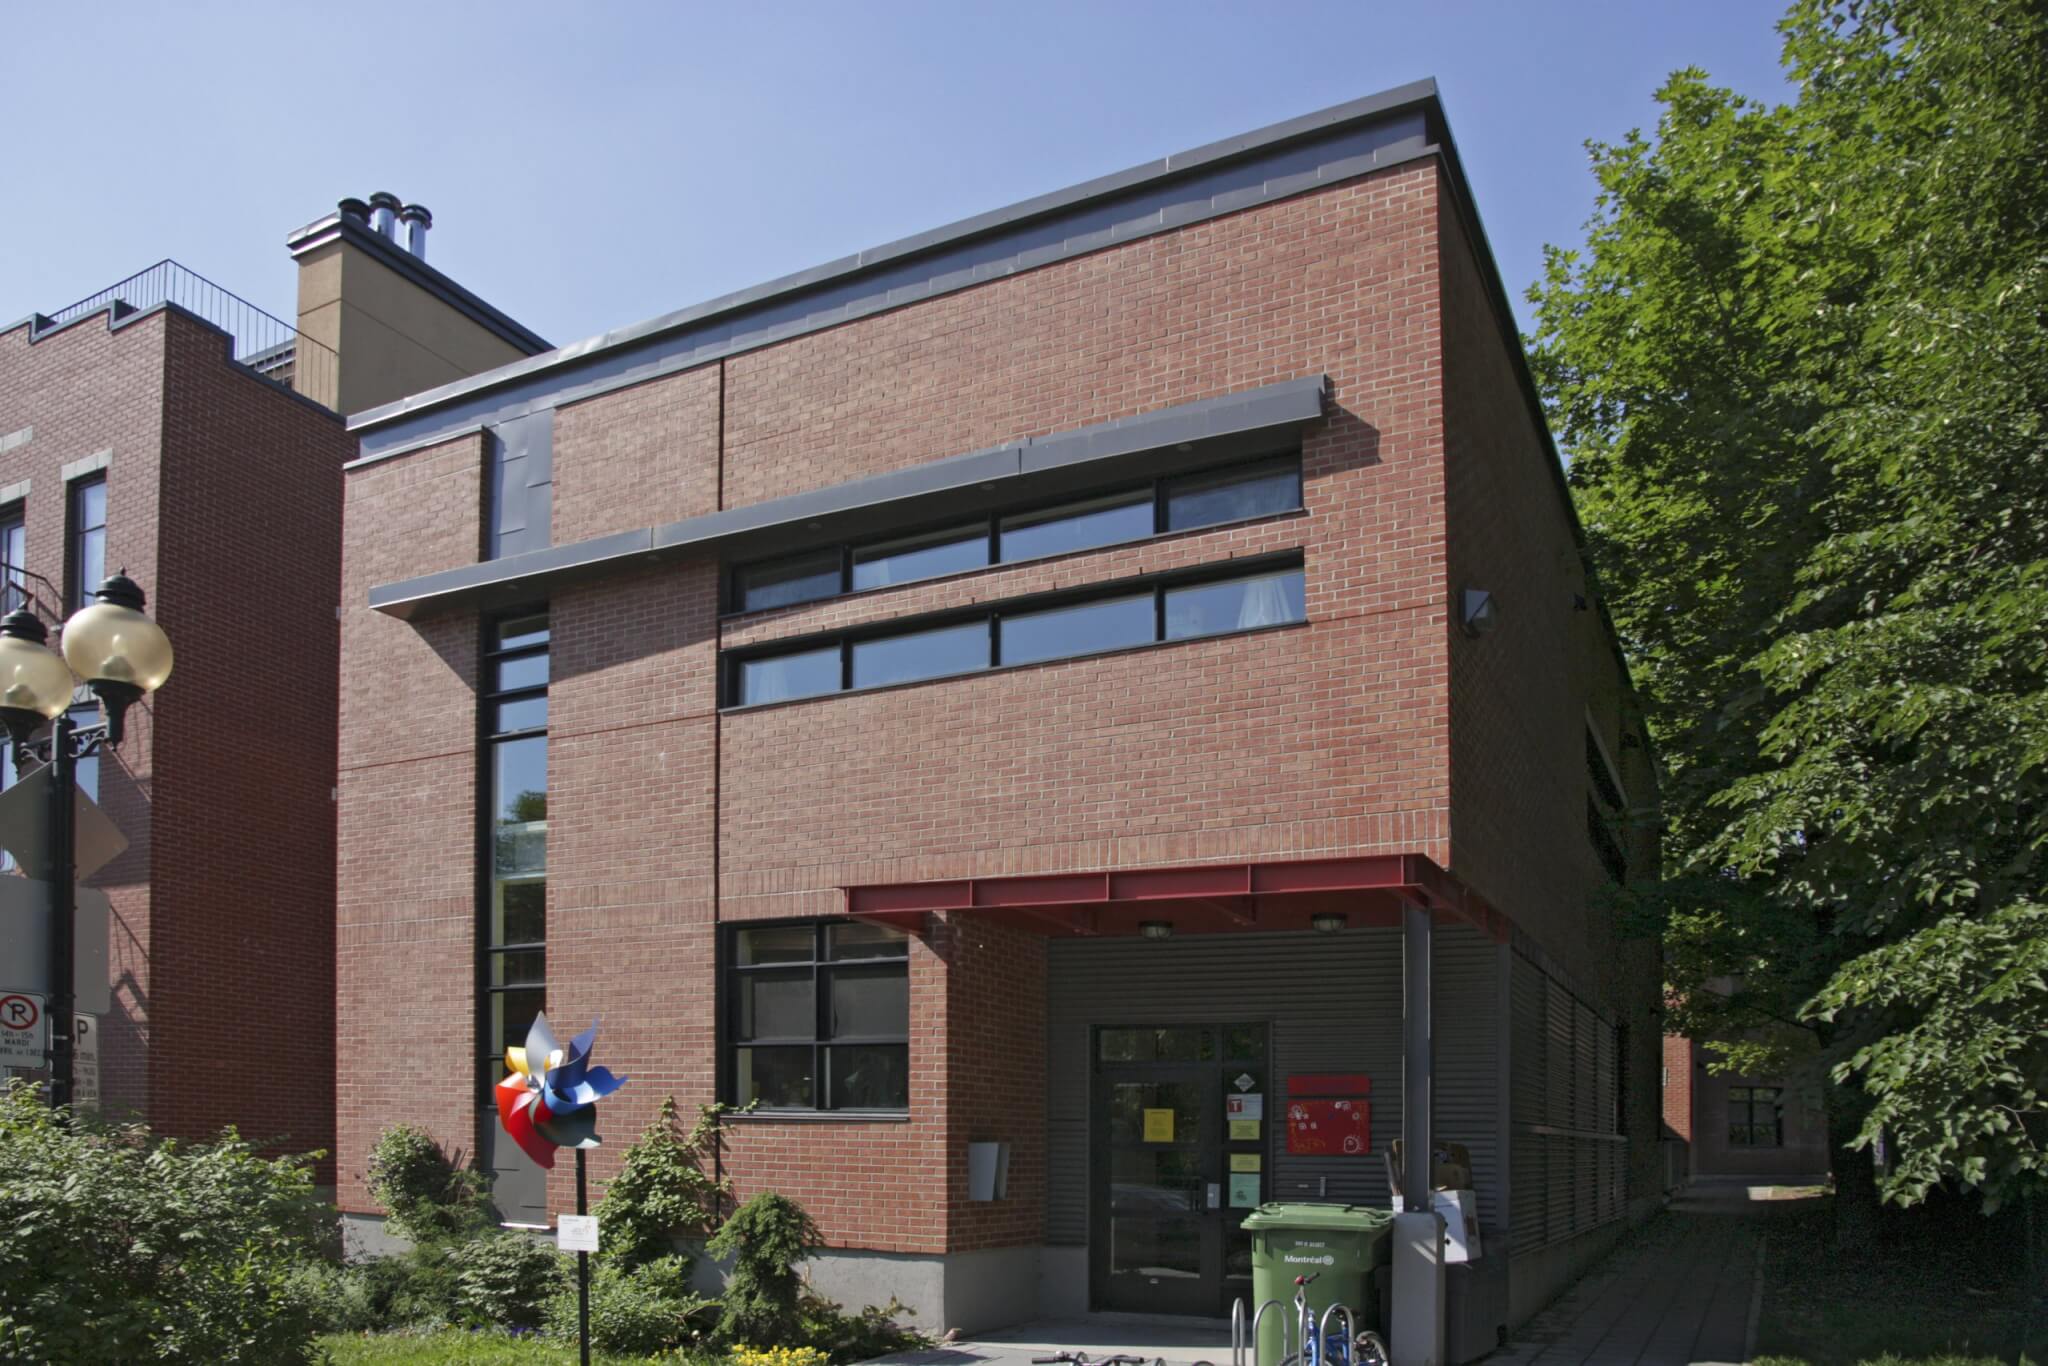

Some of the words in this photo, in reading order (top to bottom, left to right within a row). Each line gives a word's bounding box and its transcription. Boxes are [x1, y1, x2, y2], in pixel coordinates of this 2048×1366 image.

[77, 1019, 88, 1045] P
[4, 1038, 30, 1046] MARDI
[1284, 1255, 1321, 1264] Montréal
